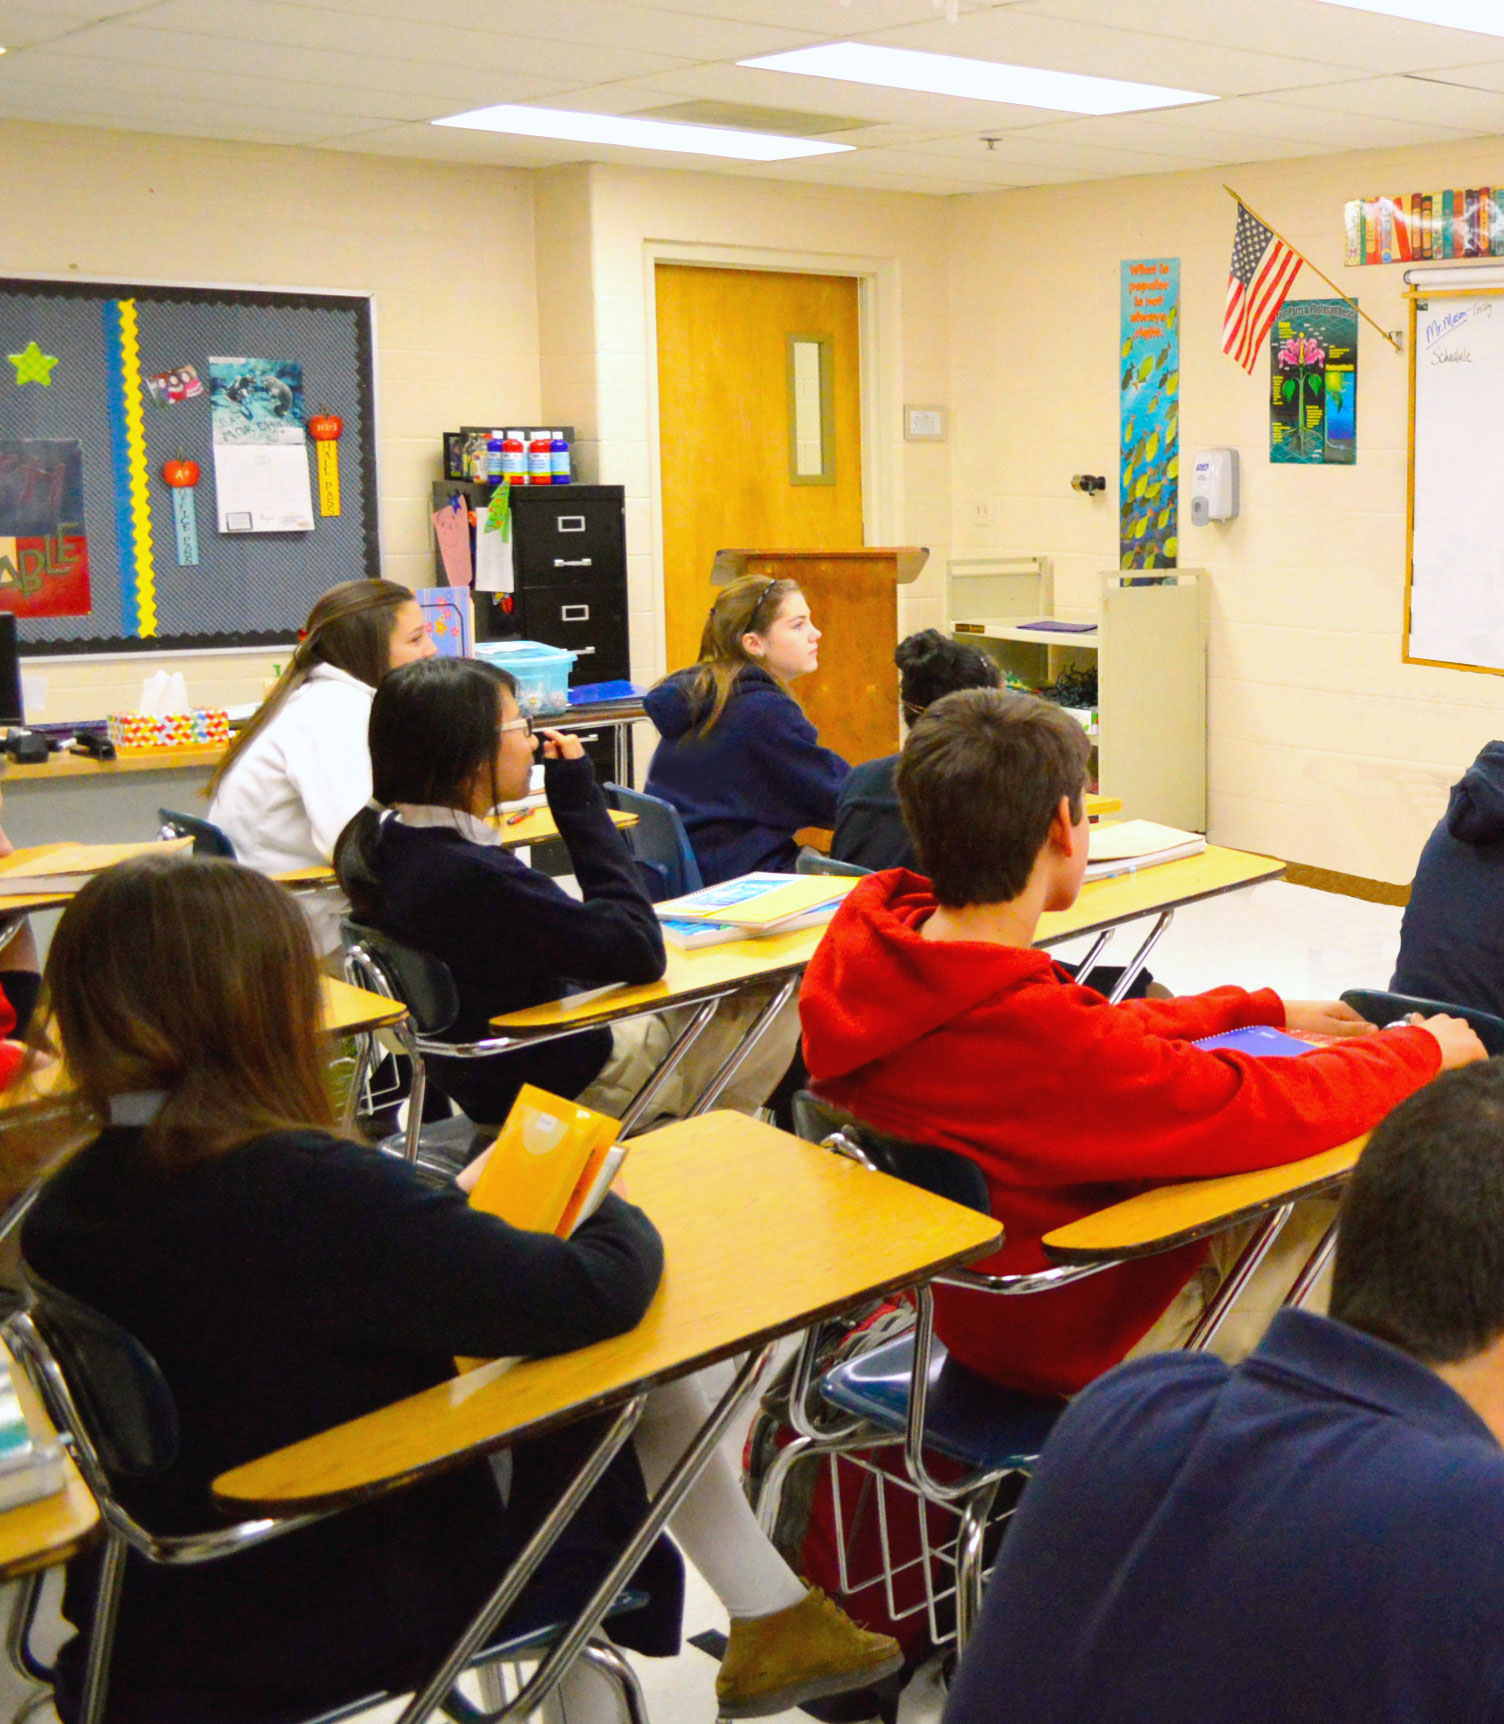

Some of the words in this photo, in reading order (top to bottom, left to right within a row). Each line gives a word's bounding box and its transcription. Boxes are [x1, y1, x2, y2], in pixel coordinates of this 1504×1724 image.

[1129, 263, 1158, 275] What
[1159, 263, 1170, 275] is
[1129, 278, 1170, 294] popular
[1133, 295, 1145, 307] is
[1146, 295, 1165, 307] not
[1129, 310, 1167, 324] always
